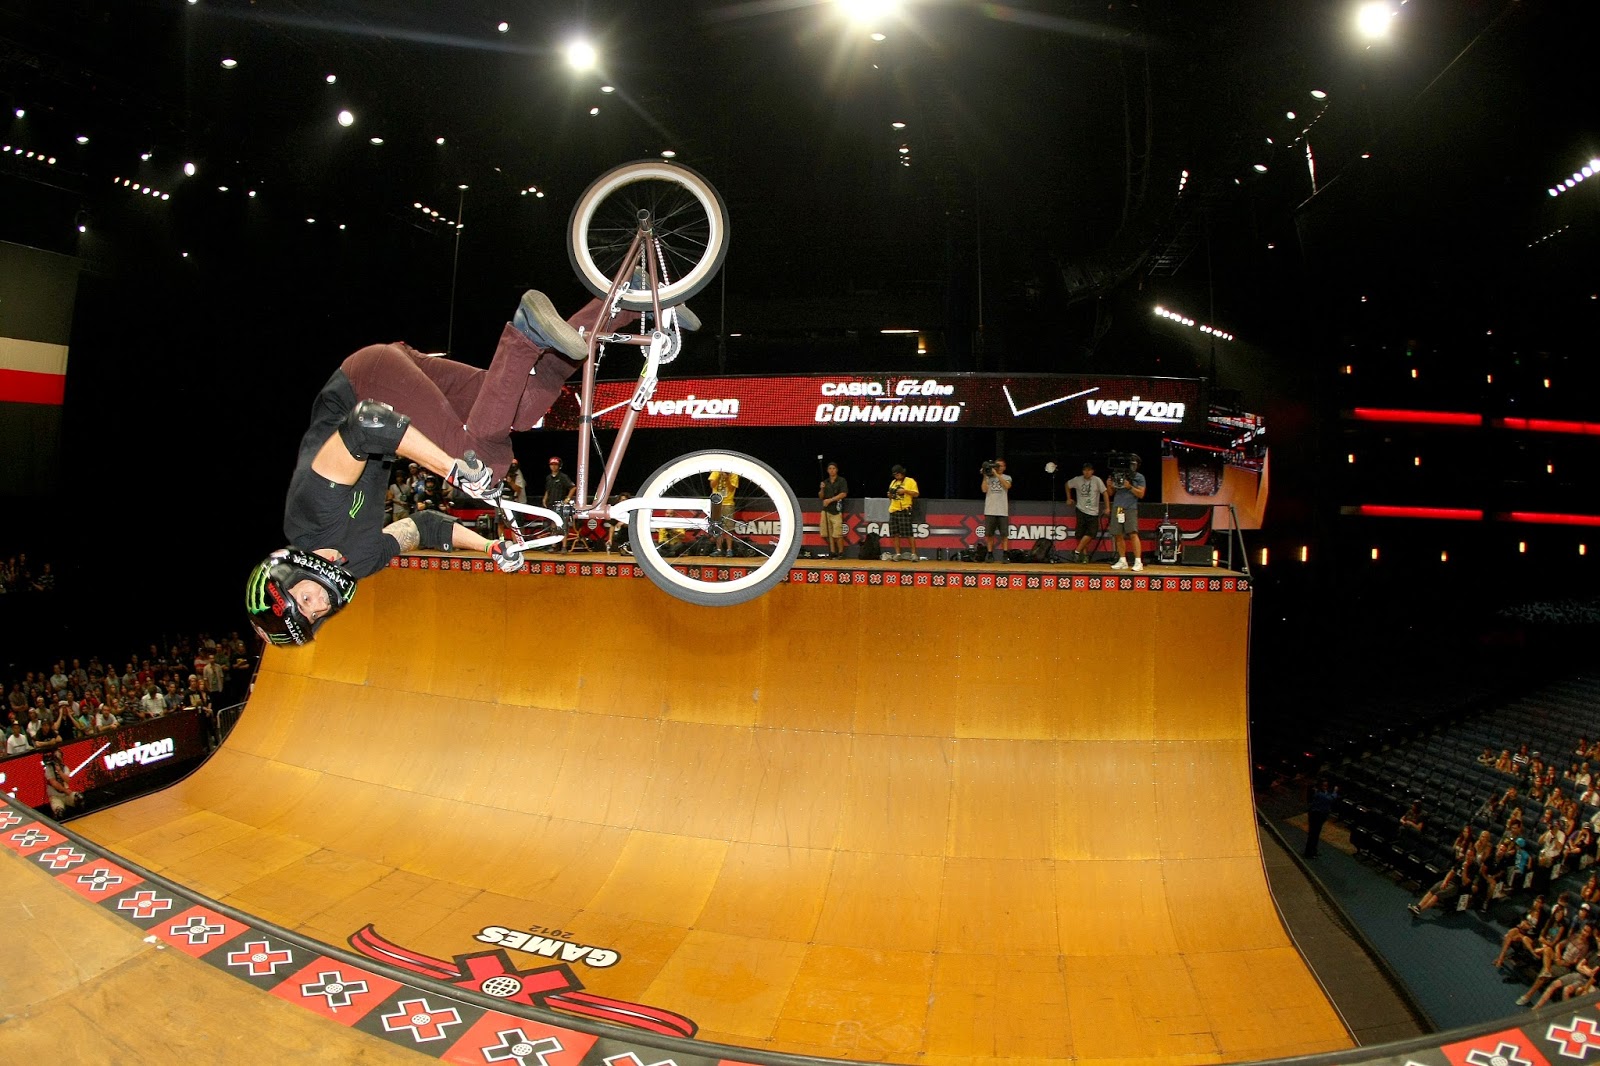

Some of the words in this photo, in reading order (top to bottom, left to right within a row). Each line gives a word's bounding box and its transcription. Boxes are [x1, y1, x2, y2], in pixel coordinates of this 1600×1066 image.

[647, 395, 739, 418] verizon
[814, 403, 961, 422] COMMANDO
[1087, 396, 1186, 423] verizon
[734, 521, 782, 535] GAME
[867, 523, 930, 538] GAES
[1007, 525, 1067, 540] GAMES
[267, 581, 286, 609] TOYOTA
[104, 737, 174, 770] verizon
[528, 924, 575, 939] 2012
[474, 925, 619, 968] GAMES
